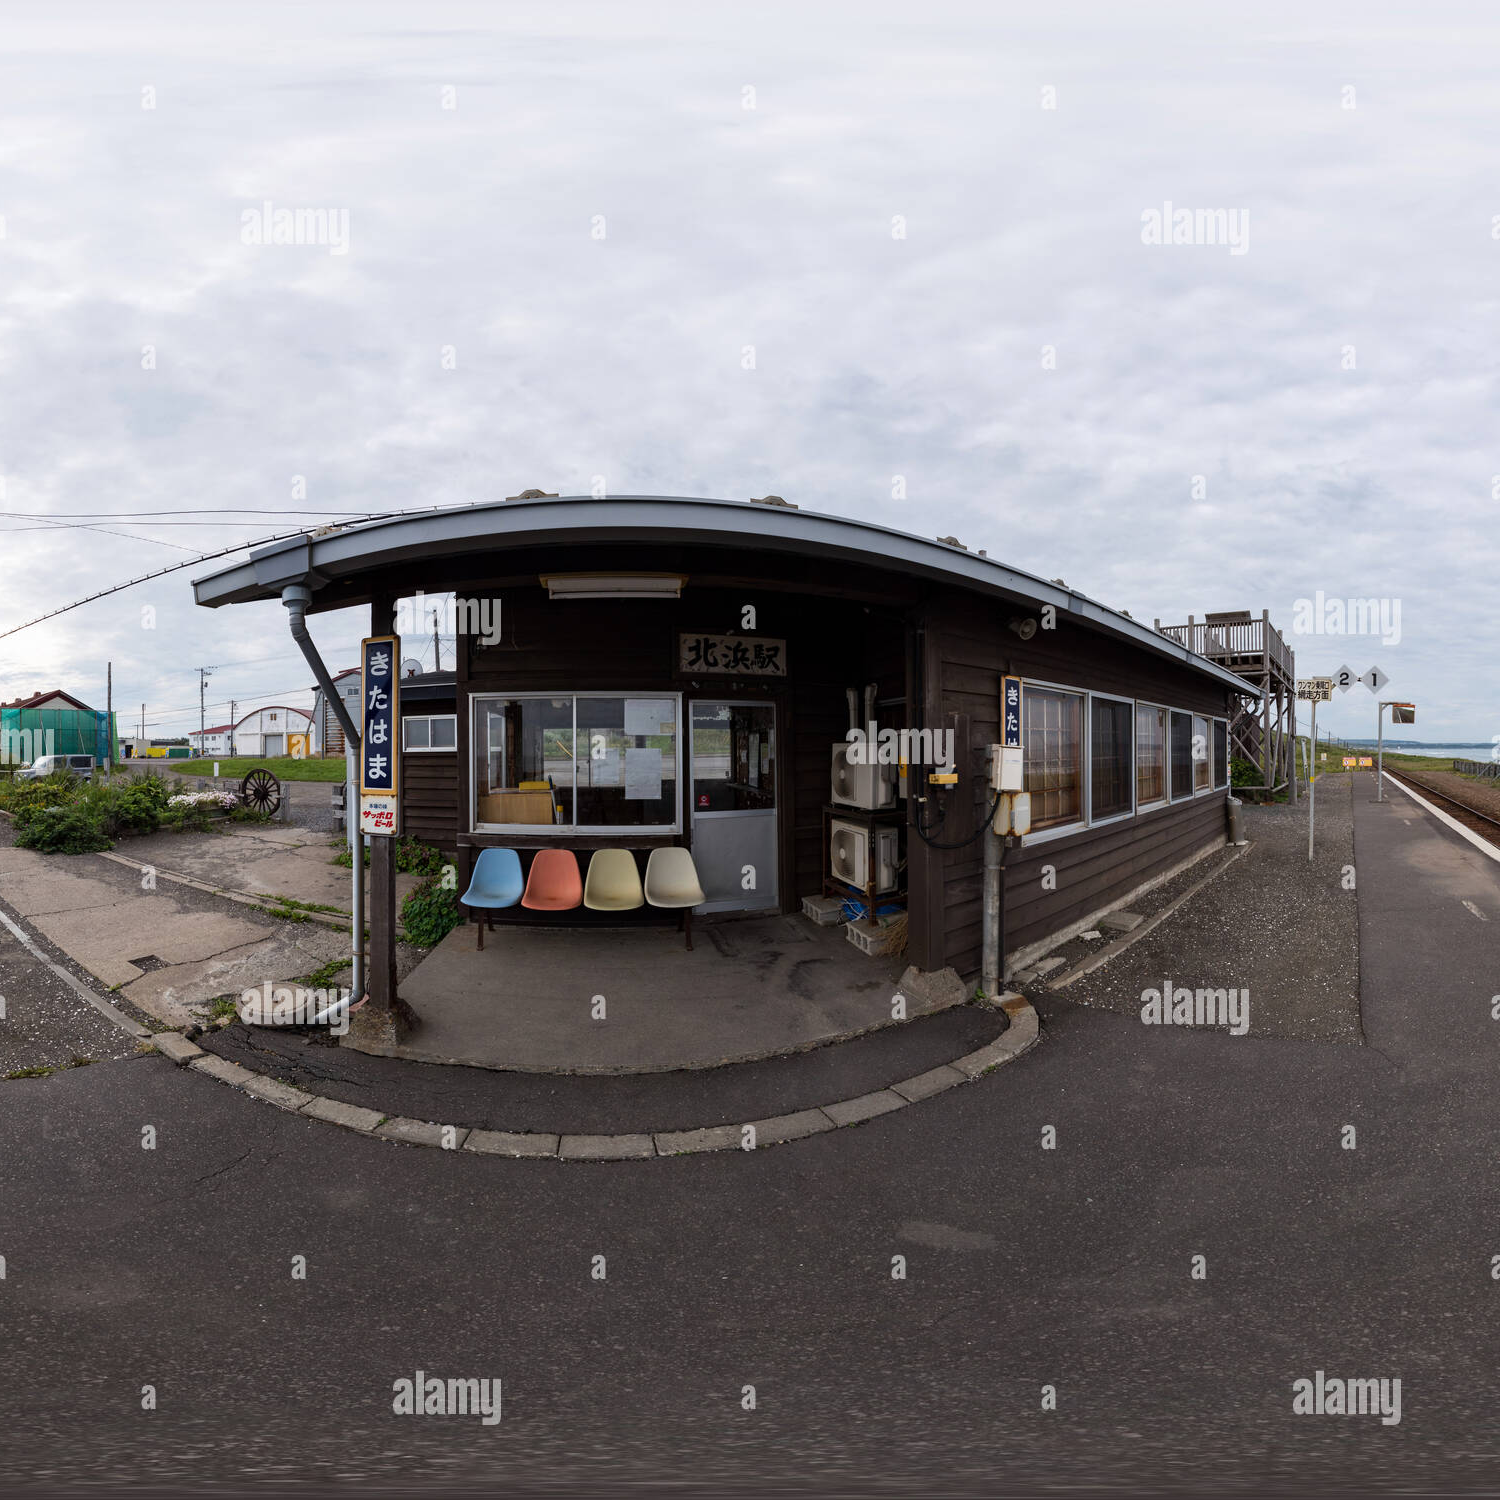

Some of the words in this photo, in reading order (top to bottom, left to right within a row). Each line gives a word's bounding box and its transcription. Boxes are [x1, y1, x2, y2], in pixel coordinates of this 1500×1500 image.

[688, 638, 780, 671] 北浜駅
[1339, 672, 1349, 686] 2
[1371, 673, 1377, 686] 1
[368, 651, 389, 780] きたはま
[362, 810, 394, 820] サッポロ
[374, 819, 394, 828] ビール
